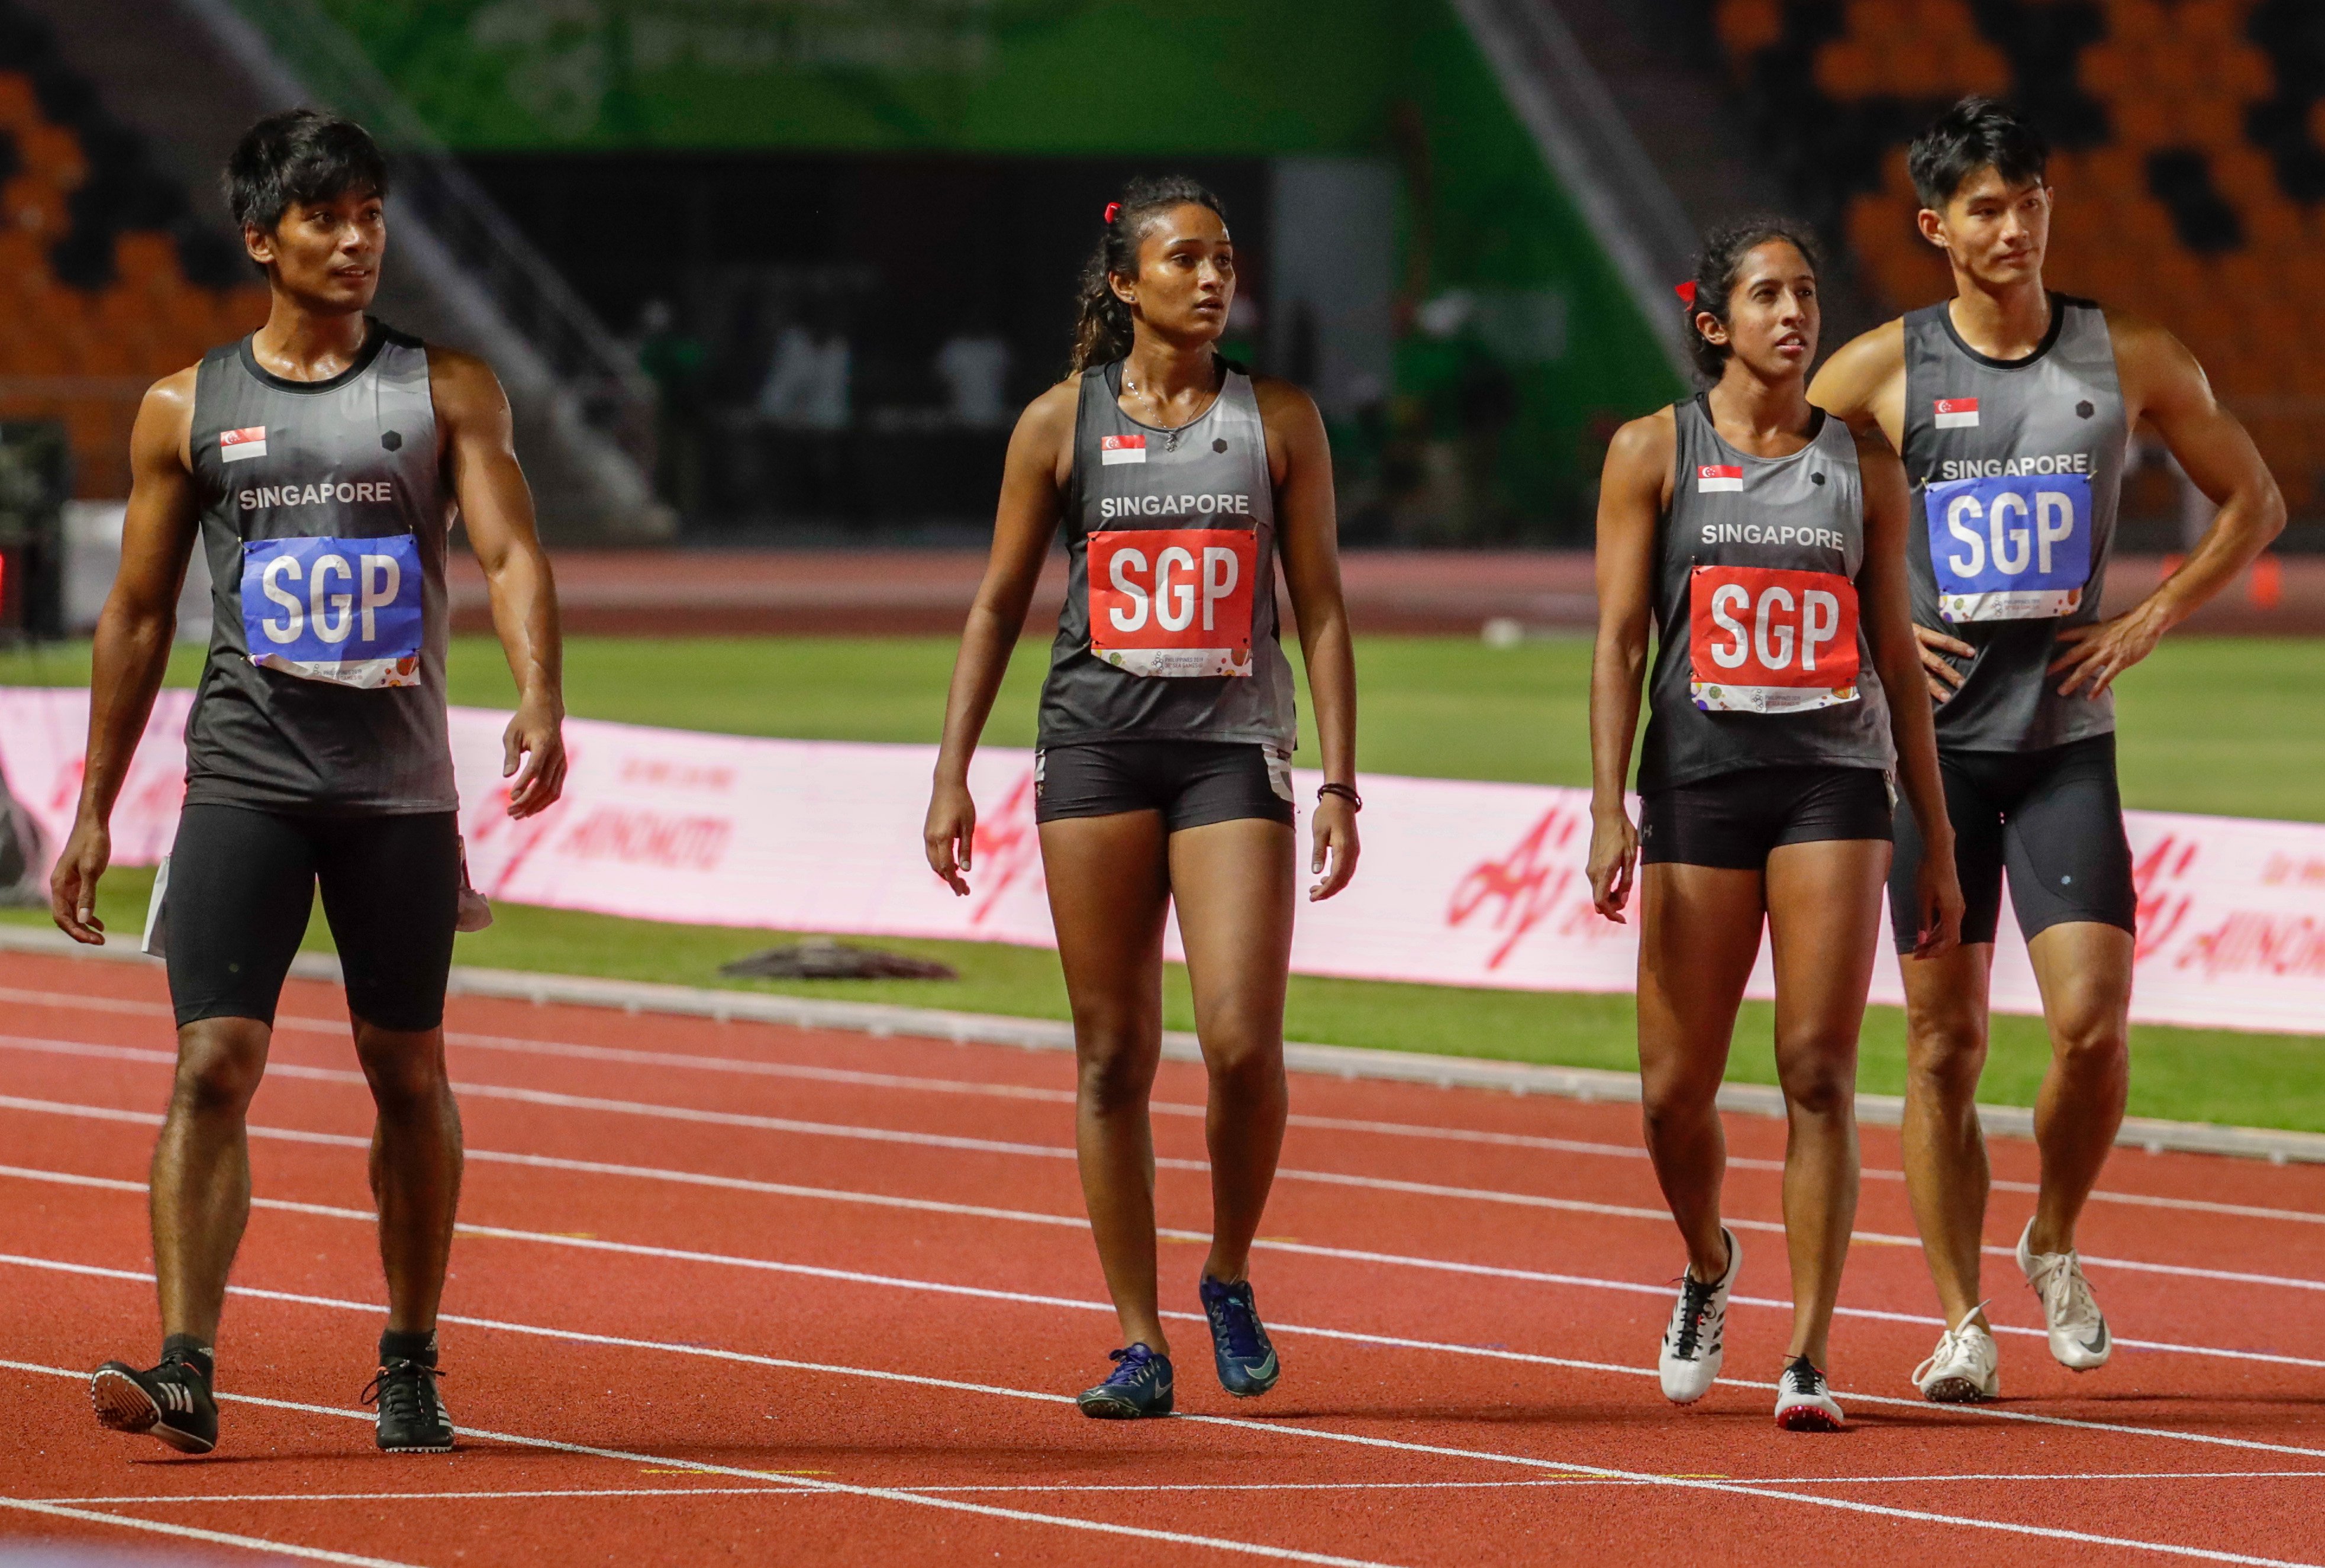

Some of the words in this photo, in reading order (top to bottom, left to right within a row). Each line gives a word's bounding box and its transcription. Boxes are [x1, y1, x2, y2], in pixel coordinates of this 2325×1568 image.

[1942, 454, 2088, 480] SINGAPORE
[240, 482, 391, 510] SINGAPORE
[1101, 494, 1249, 517] SINGAPORE
[1701, 524, 1844, 551] SINGAPORE
[1947, 492, 2074, 578] SGP
[262, 554, 401, 644] SGP
[1109, 546, 1239, 633] SGP
[1710, 583, 1839, 671] SGP
